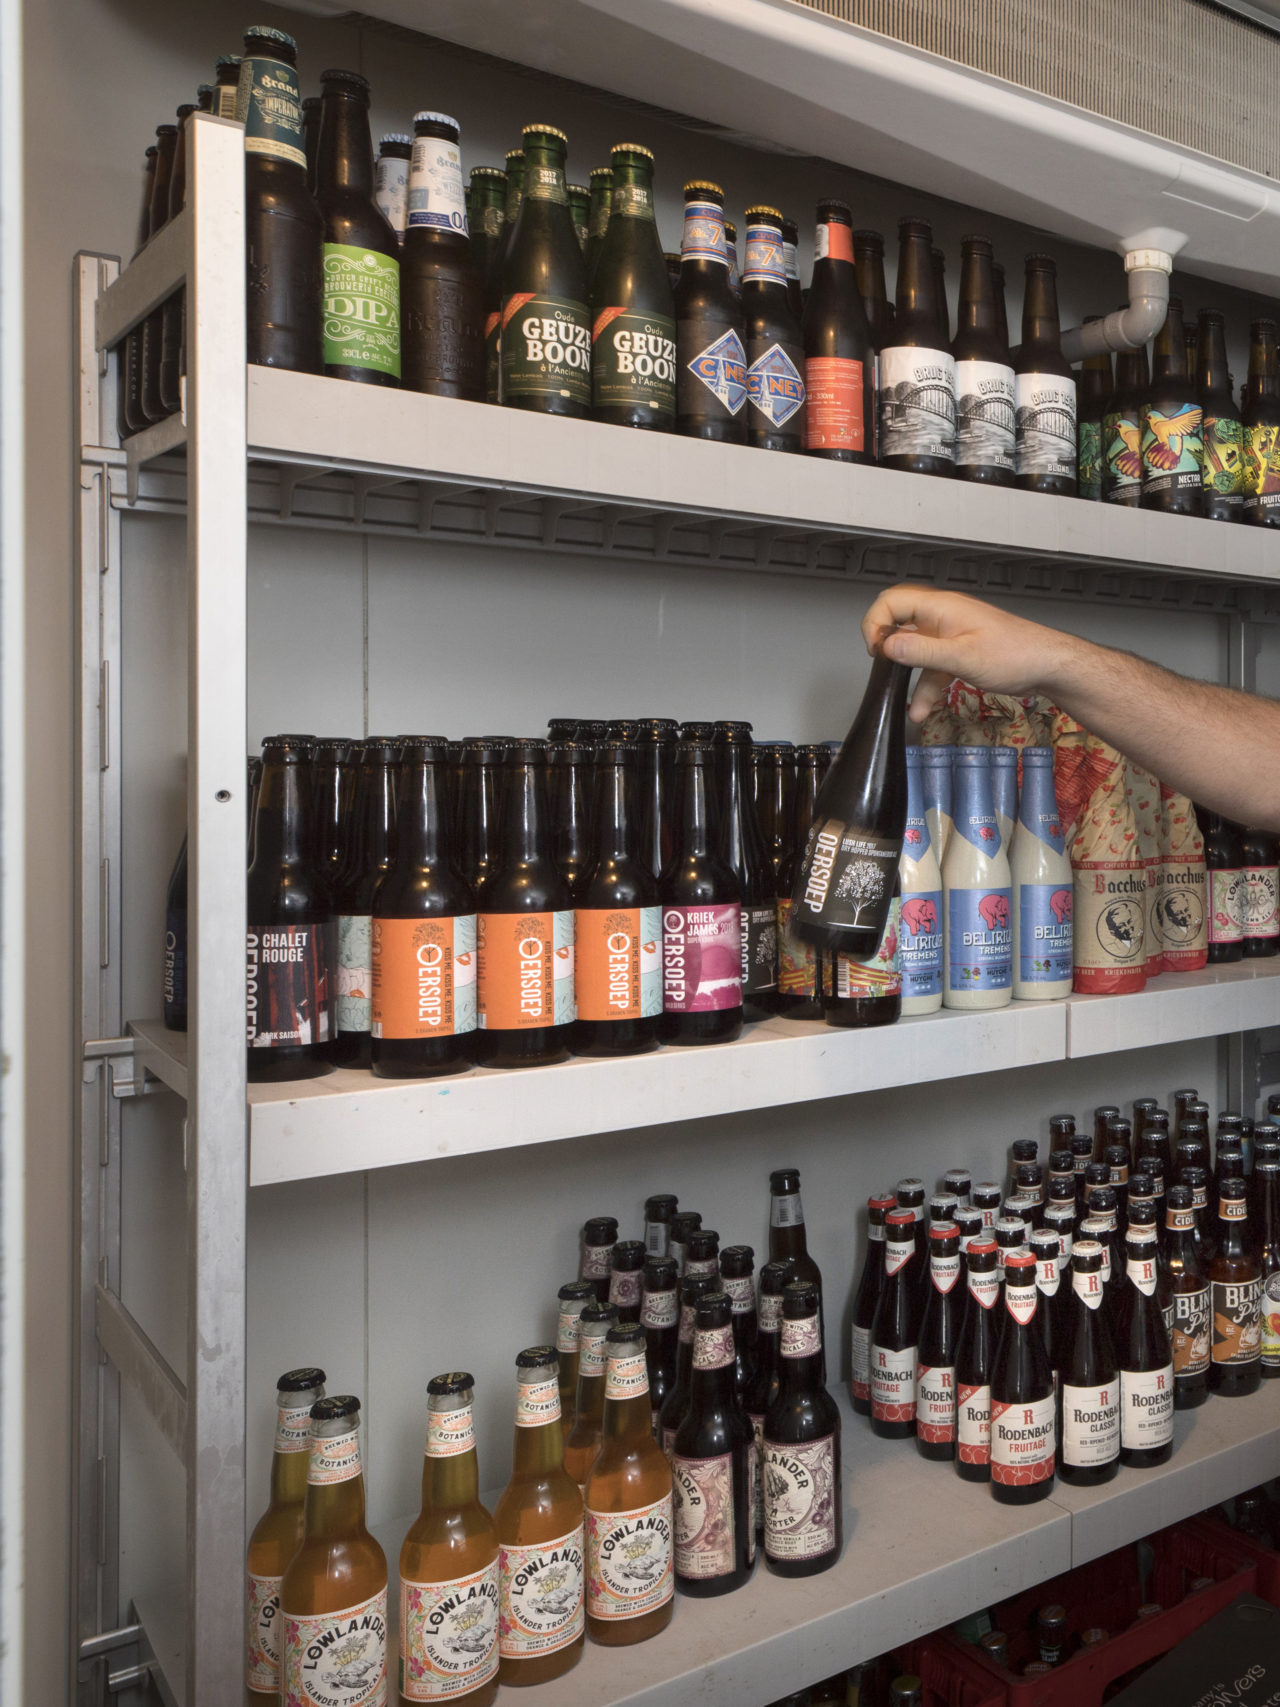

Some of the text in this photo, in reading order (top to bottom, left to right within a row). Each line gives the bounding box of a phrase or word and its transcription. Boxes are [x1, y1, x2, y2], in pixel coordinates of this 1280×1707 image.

[261, 74, 298, 98] Brand
[325, 297, 400, 328] DIPA
[555, 310, 575, 323] Oude
[522, 318, 591, 352] GEUZE
[526, 340, 591, 372] BOON
[804, 832, 838, 913] OERSOEP
[1093, 874, 1146, 895] Bacchus
[687, 912, 714, 924] KRIEK
[687, 924, 719, 936] JAMES
[262, 932, 308, 948] CHALET
[262, 948, 304, 964] ROUGE
[664, 910, 686, 1002] OERSOEP
[518, 937, 544, 1017] OERSOEP
[608, 932, 630, 1009] OERSOEP
[416, 944, 443, 1026] OERSOEP
[1044, 1262, 1055, 1280] R
[1143, 1262, 1153, 1279] R
[1088, 1274, 1098, 1292] R
[1225, 1281, 1262, 1309] BLIN
[1176, 1292, 1210, 1319] BLIN
[612, 1372, 648, 1386] BOTANICA
[1156, 1374, 1166, 1390] R
[920, 1386, 953, 1402] RODEN
[959, 1388, 972, 1401] NEW
[1100, 1390, 1108, 1406] R
[1132, 1392, 1174, 1408] RODENBA
[524, 1398, 561, 1412] BOTANICA
[991, 1404, 1004, 1418] NEW
[1148, 1402, 1172, 1416] CLASSIC
[1022, 1408, 1034, 1424] R
[1074, 1408, 1119, 1424] RODENBA
[438, 1426, 476, 1440] BOTANICA
[998, 1424, 1054, 1442] RODENBACH
[1090, 1420, 1116, 1433] CLASSIC
[1008, 1437, 1046, 1453] FRUITAGE
[318, 1451, 360, 1468] BOTANICA
[768, 1516, 796, 1530] ORTER
[600, 1517, 670, 1561] LOWLANDER
[512, 1545, 583, 1597] LOWLANDER
[601, 1568, 630, 1594] ISLANDER
[631, 1567, 665, 1596] TROPICAL
[425, 1581, 499, 1636] LOWLANDER
[512, 1601, 579, 1631] ISLANDER TROPICAL
[303, 1614, 386, 1670] LOWLANDER
[426, 1638, 496, 1670] ISLANDER TROPICAL
[342, 1672, 380, 1706] TROPICAL
